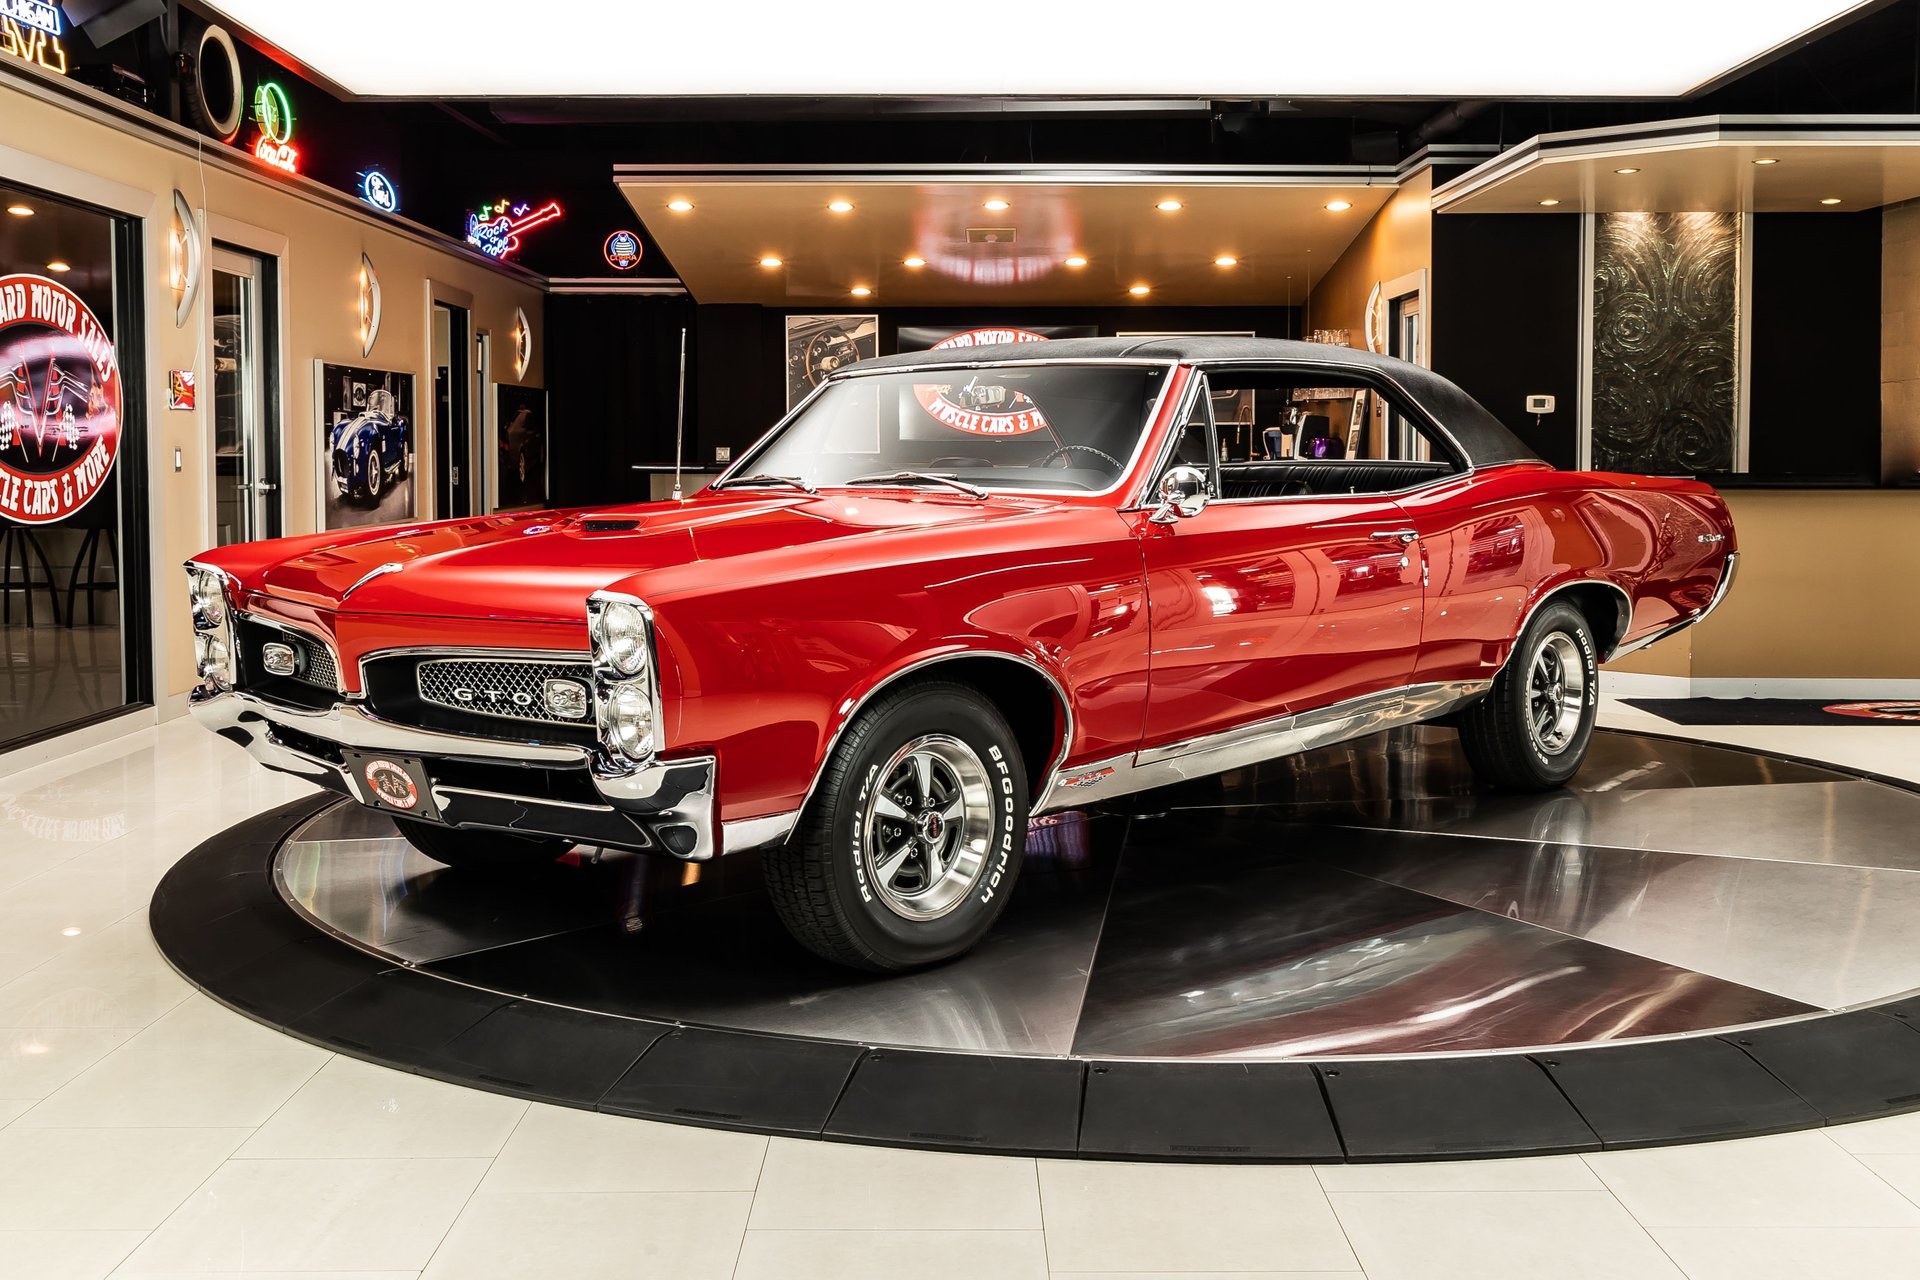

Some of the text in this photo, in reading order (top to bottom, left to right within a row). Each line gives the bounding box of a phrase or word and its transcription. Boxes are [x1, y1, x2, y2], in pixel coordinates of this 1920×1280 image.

[30, 283, 77, 334] MOTOR
[78, 314, 116, 383] SALES
[927, 397, 979, 431] MUSCLE
[980, 415, 1015, 433] CARS
[1017, 413, 1030, 431] &
[23, 478, 59, 515] CARS
[63, 472, 74, 507] &
[76, 434, 111, 500] MORE
[453, 687, 532, 706] GTO
[1575, 628, 1596, 707] Radial T/A
[852, 763, 879, 904] Radial T/A
[980, 744, 1015, 904] BFGoodrich
